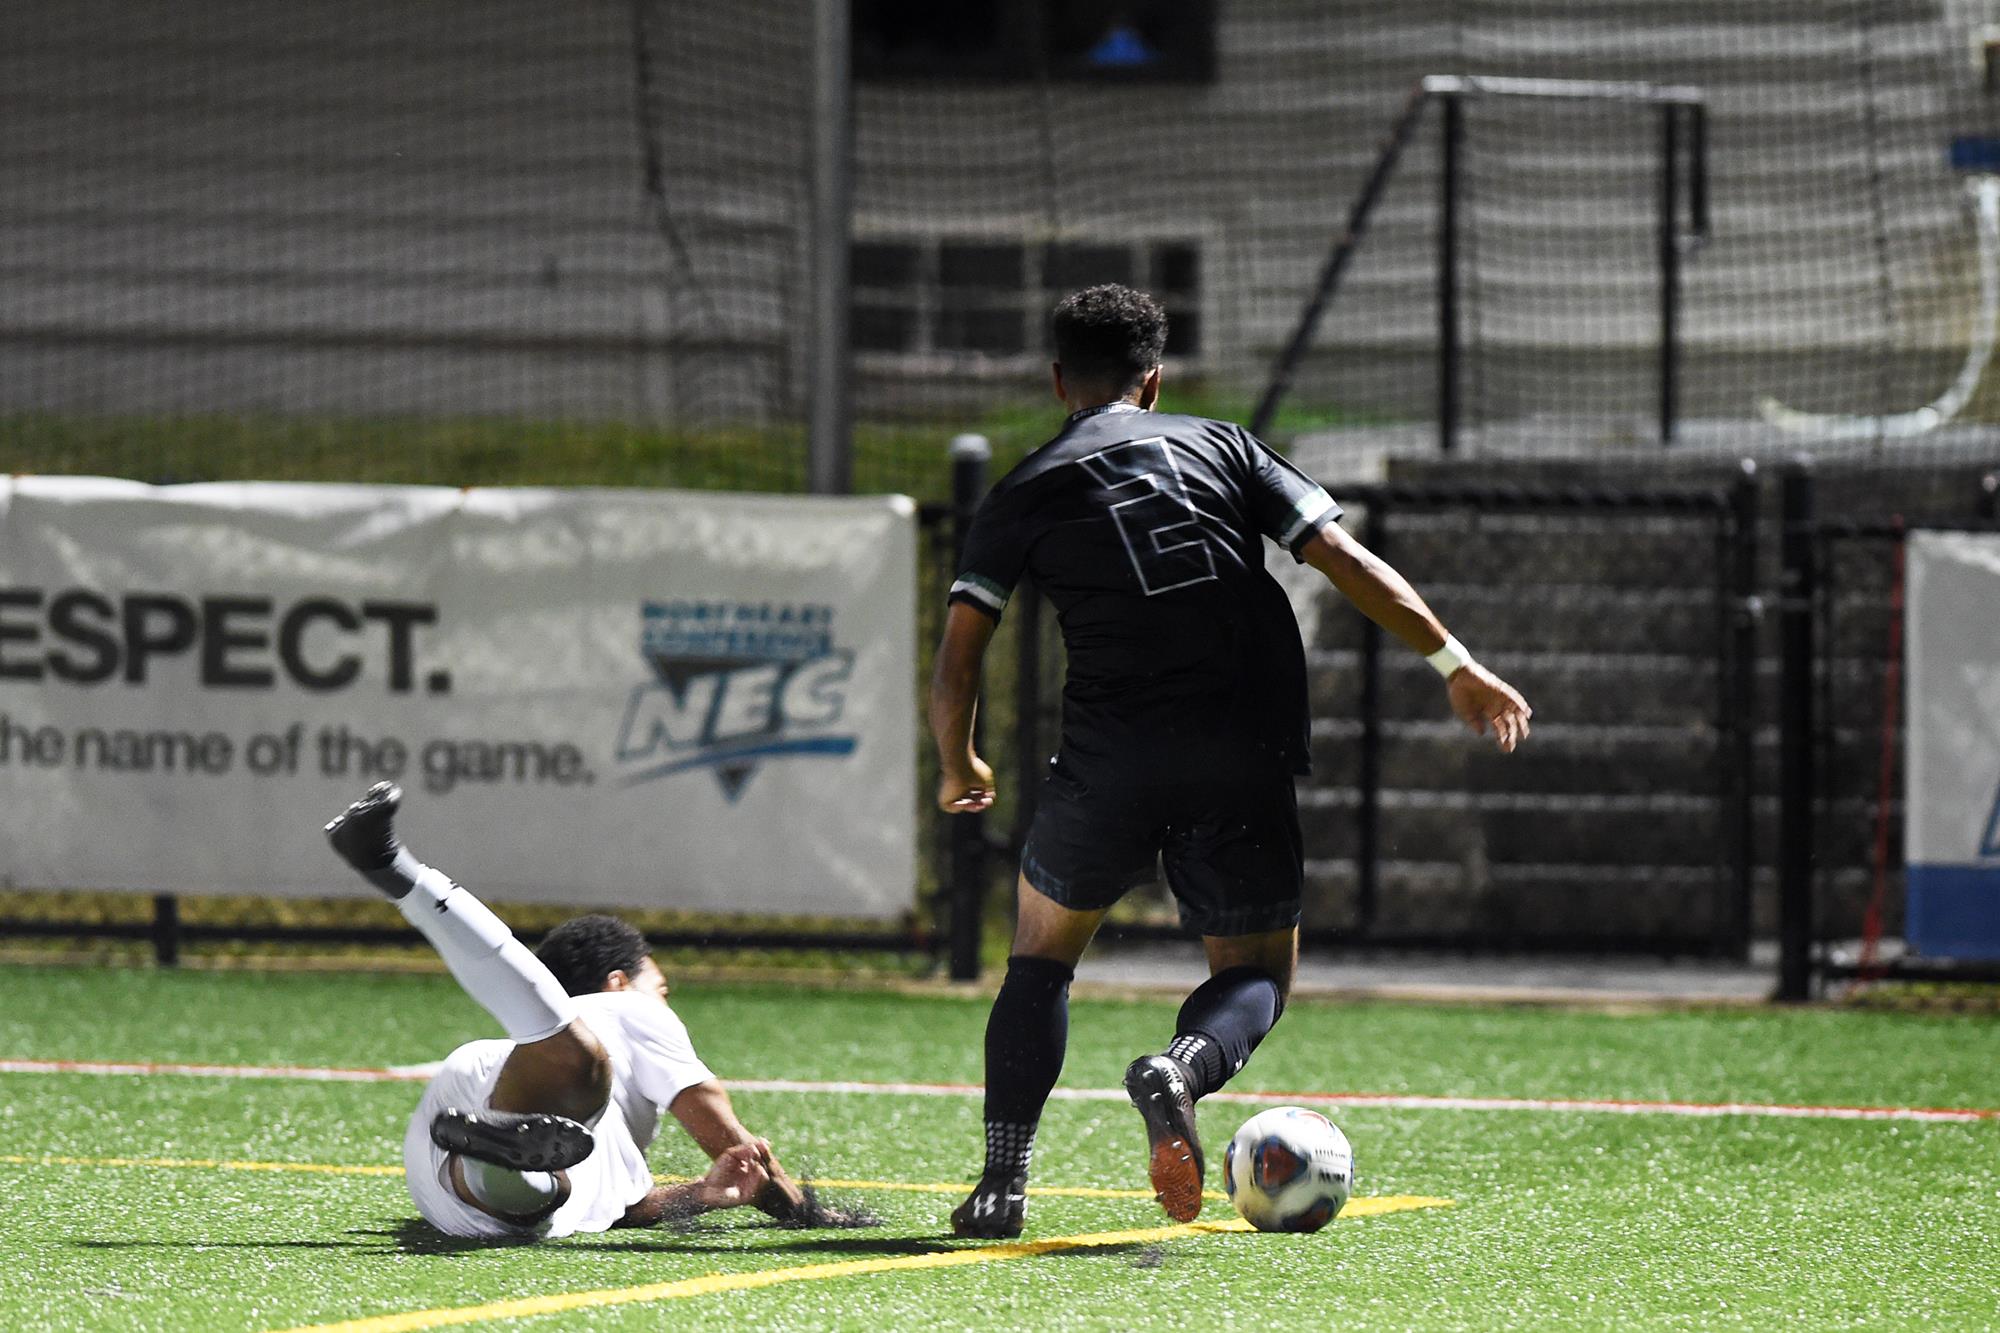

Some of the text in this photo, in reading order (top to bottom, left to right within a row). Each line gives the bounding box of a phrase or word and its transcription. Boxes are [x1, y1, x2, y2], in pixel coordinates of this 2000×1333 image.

[1076, 436, 1219, 596] 2
[74, 726, 233, 776] name
[247, 721, 304, 776] of
[319, 724, 405, 777] the
[421, 738, 595, 795] game.
[616, 648, 857, 760] NEC
